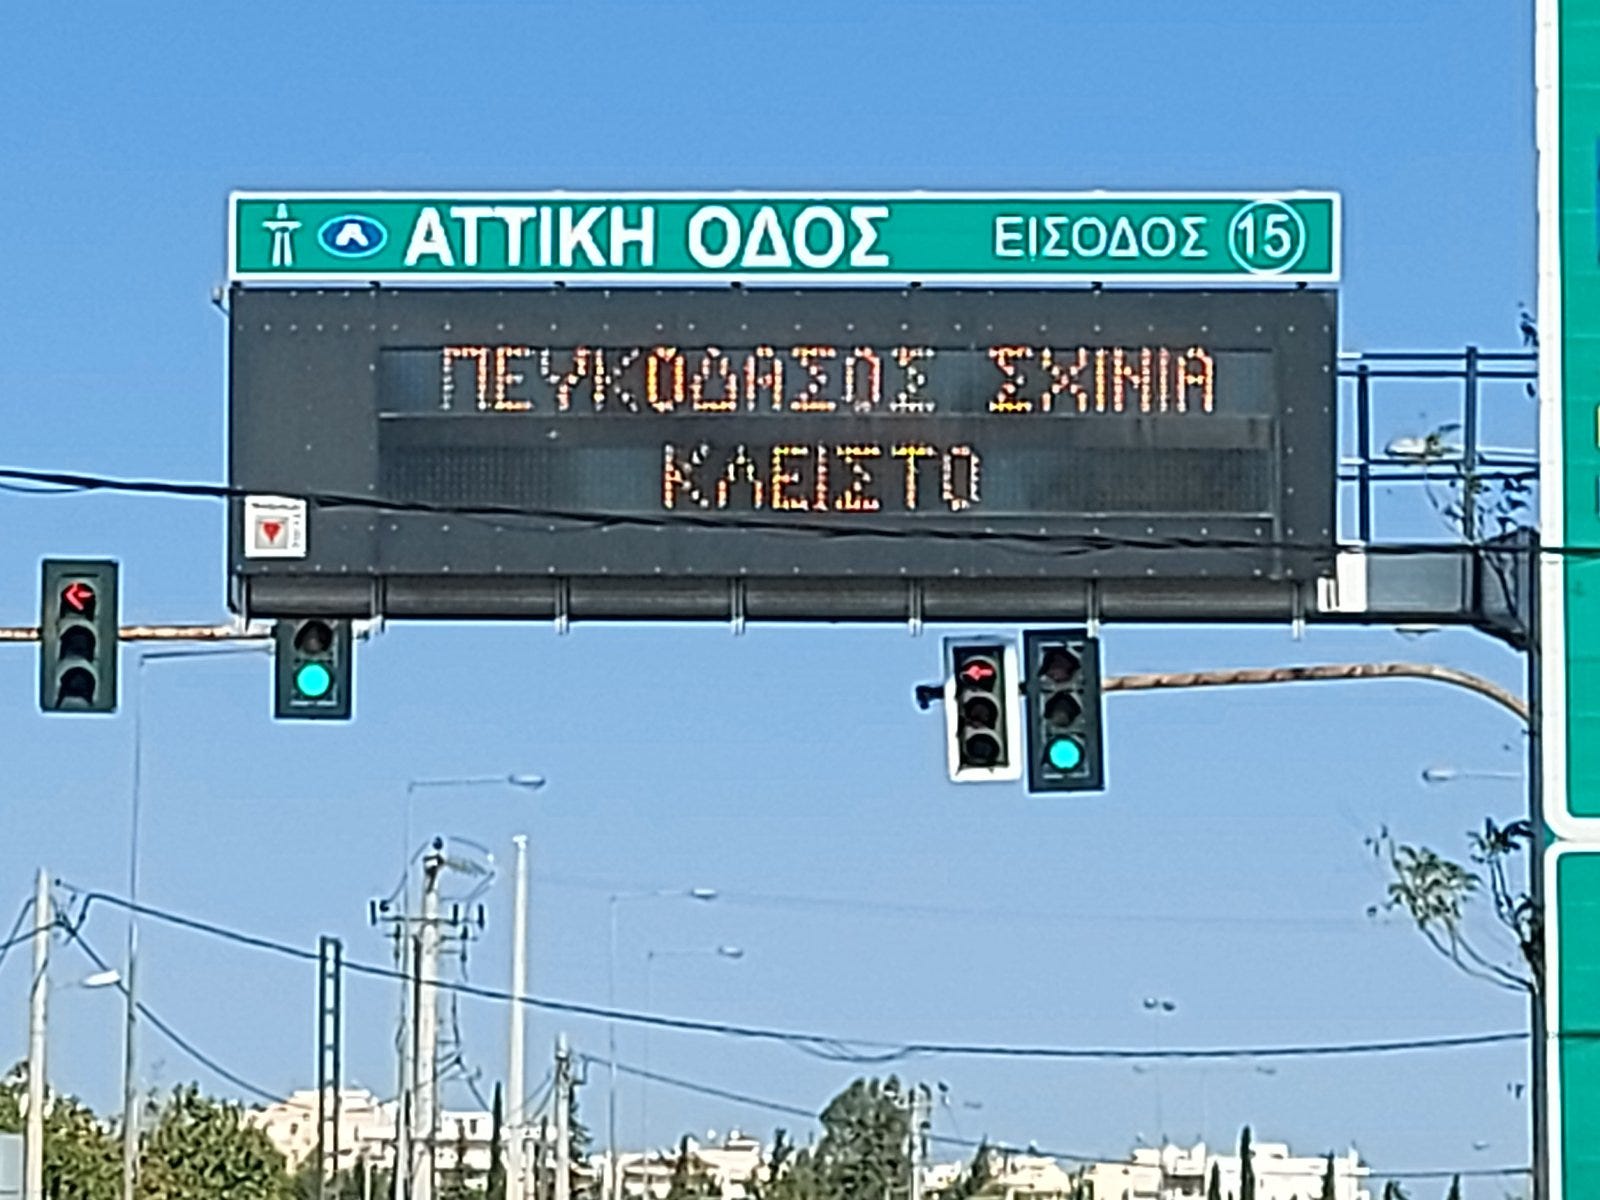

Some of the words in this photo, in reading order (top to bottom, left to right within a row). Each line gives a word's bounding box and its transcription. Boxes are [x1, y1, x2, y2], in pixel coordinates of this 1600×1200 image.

[404, 205, 655, 268] ΑΤΤΙΚΗ
[688, 205, 890, 269] ΟΔΟΣ
[993, 215, 1208, 258] ΕΙΣΟΔΟΣ
[1238, 212, 1291, 259] 15
[439, 346, 935, 412] ΠΕΥΚΟΔΑΣΟΣ
[988, 346, 1217, 414] ΣΧΙΝΙΑ
[663, 444, 981, 511] ΚΛΕΙΣΤΟ
